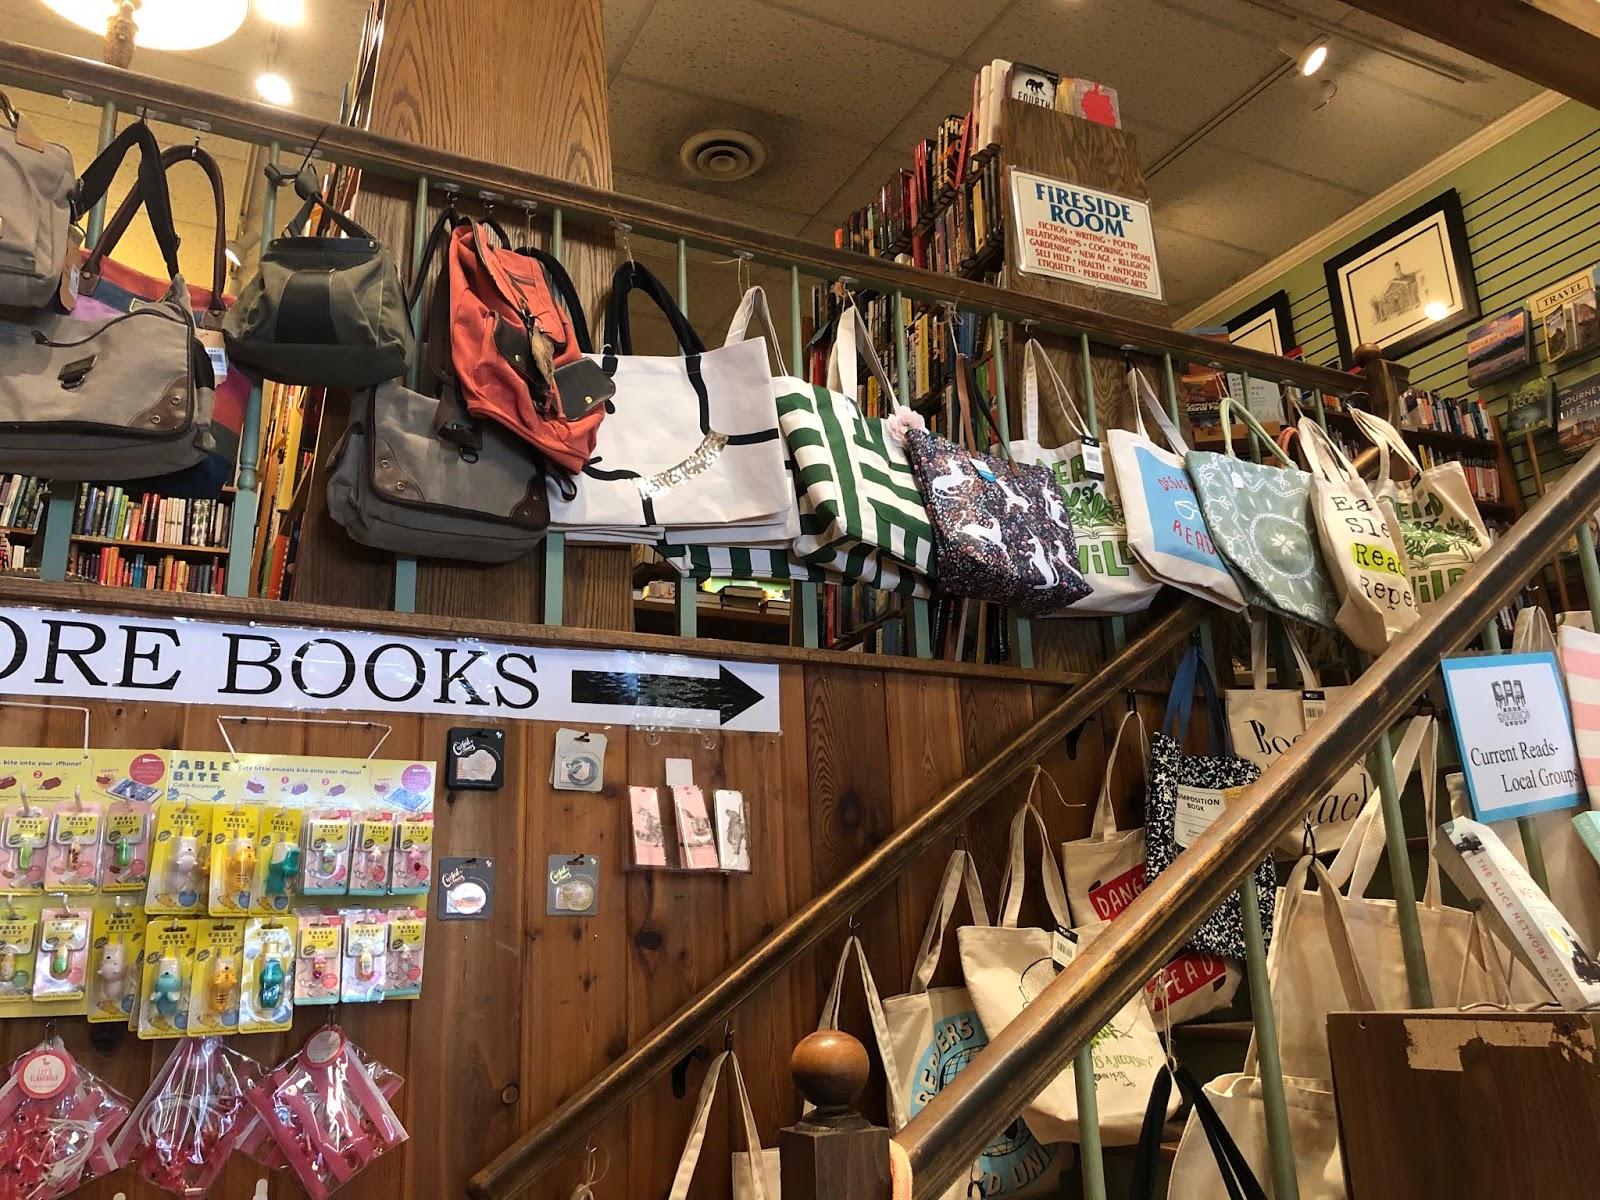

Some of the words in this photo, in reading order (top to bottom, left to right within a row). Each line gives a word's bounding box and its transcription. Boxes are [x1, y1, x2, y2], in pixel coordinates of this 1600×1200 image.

[1036, 183, 1133, 222] FIRESIDE
[1038, 221, 1068, 234] FICTION
[1074, 230, 1106, 244] WRITING
[1113, 238, 1138, 250] POETRY
[1050, 204, 1125, 238] ROOM
[1026, 228, 1082, 247] RELATIONSHIPS
[1088, 242, 1123, 256] COOKING
[1130, 252, 1151, 262] HOME
[1030, 238, 1072, 254] GARDENING
[1079, 250, 1096, 260] NEW
[1097, 254, 1110, 262] AGE
[1118, 258, 1150, 271] RELIGION
[1035, 248, 1051, 259] SELF
[1053, 252, 1070, 262] HELP
[1078, 258, 1105, 270] HEALTH
[1112, 266, 1148, 280] ANTIQUES
[1038, 259, 1076, 274] ETIQUETTE
[1084, 270, 1129, 285] PERFORMING
[1130, 278, 1148, 289] ARTS
[1544, 282, 1584, 306] TRAVEL
[217, 633, 540, 710] BOOKS
[1470, 744, 1520, 766] Current
[1518, 739, 1558, 759] Reads-
[174, 771, 220, 782] BITE
[1502, 770, 1537, 792] Local
[1539, 768, 1579, 788] Groups
[1177, 793, 1220, 805] OMPOSITION
[1187, 803, 1204, 812] BOOK
[1477, 858, 1491, 878] THE
[1491, 881, 1514, 909] ALICE
[1512, 912, 1549, 962] NETWORK
